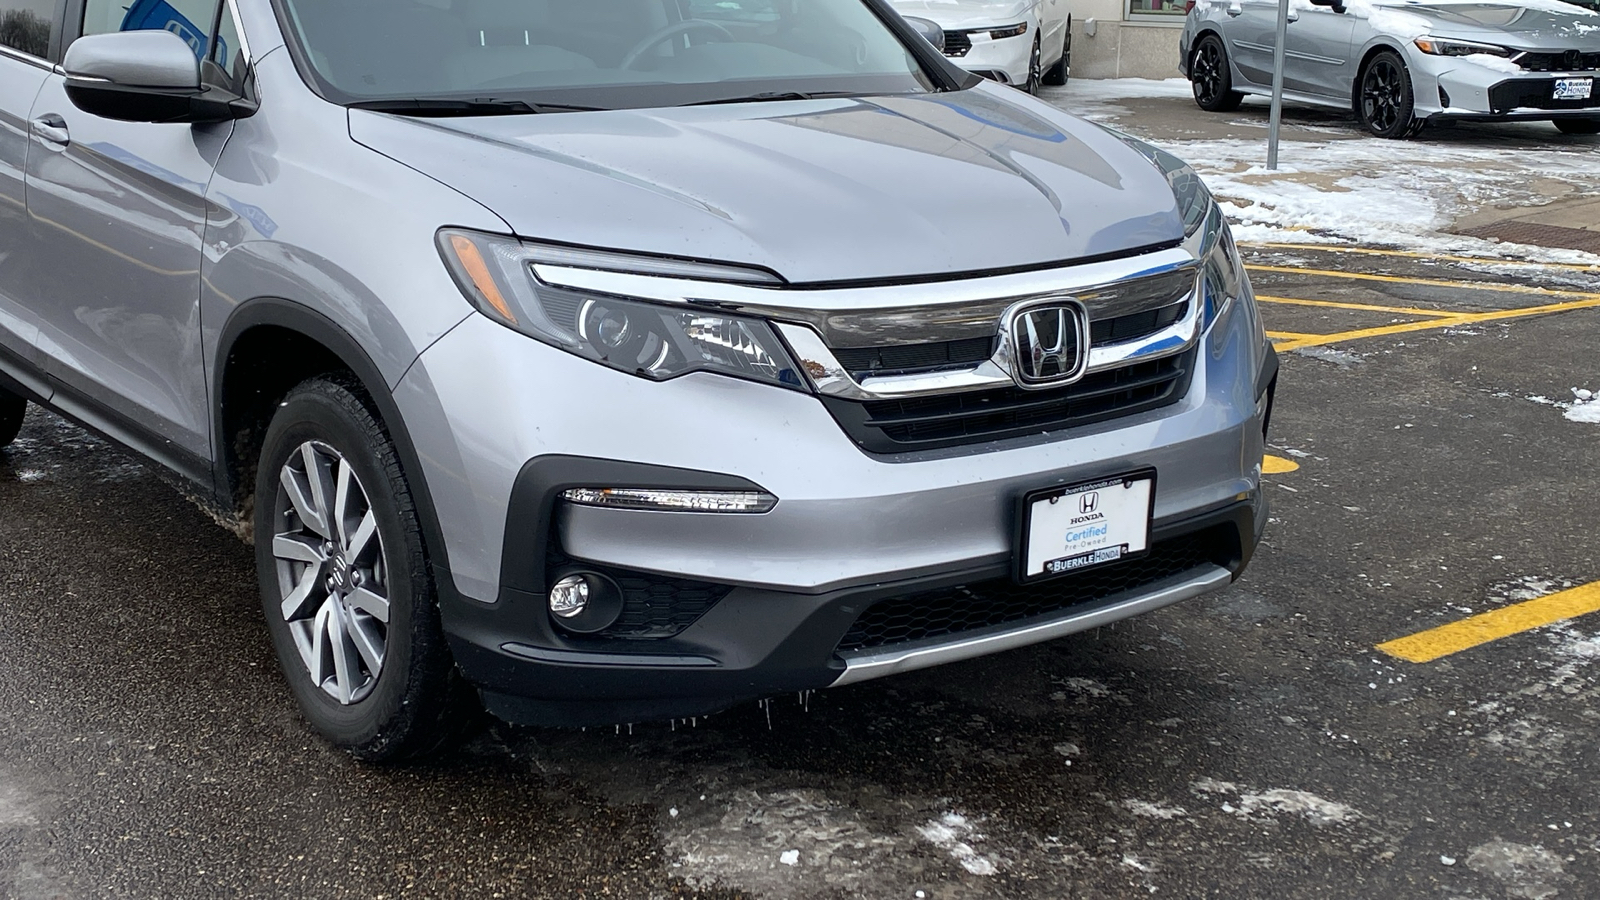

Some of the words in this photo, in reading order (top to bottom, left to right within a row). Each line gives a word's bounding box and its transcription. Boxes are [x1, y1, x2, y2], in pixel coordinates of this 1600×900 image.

[1065, 479, 1123, 495] buerklehonda.com
[1070, 512, 1104, 525] HONDA
[1065, 524, 1107, 542] Certified
[1064, 537, 1107, 551] Pre-Owned
